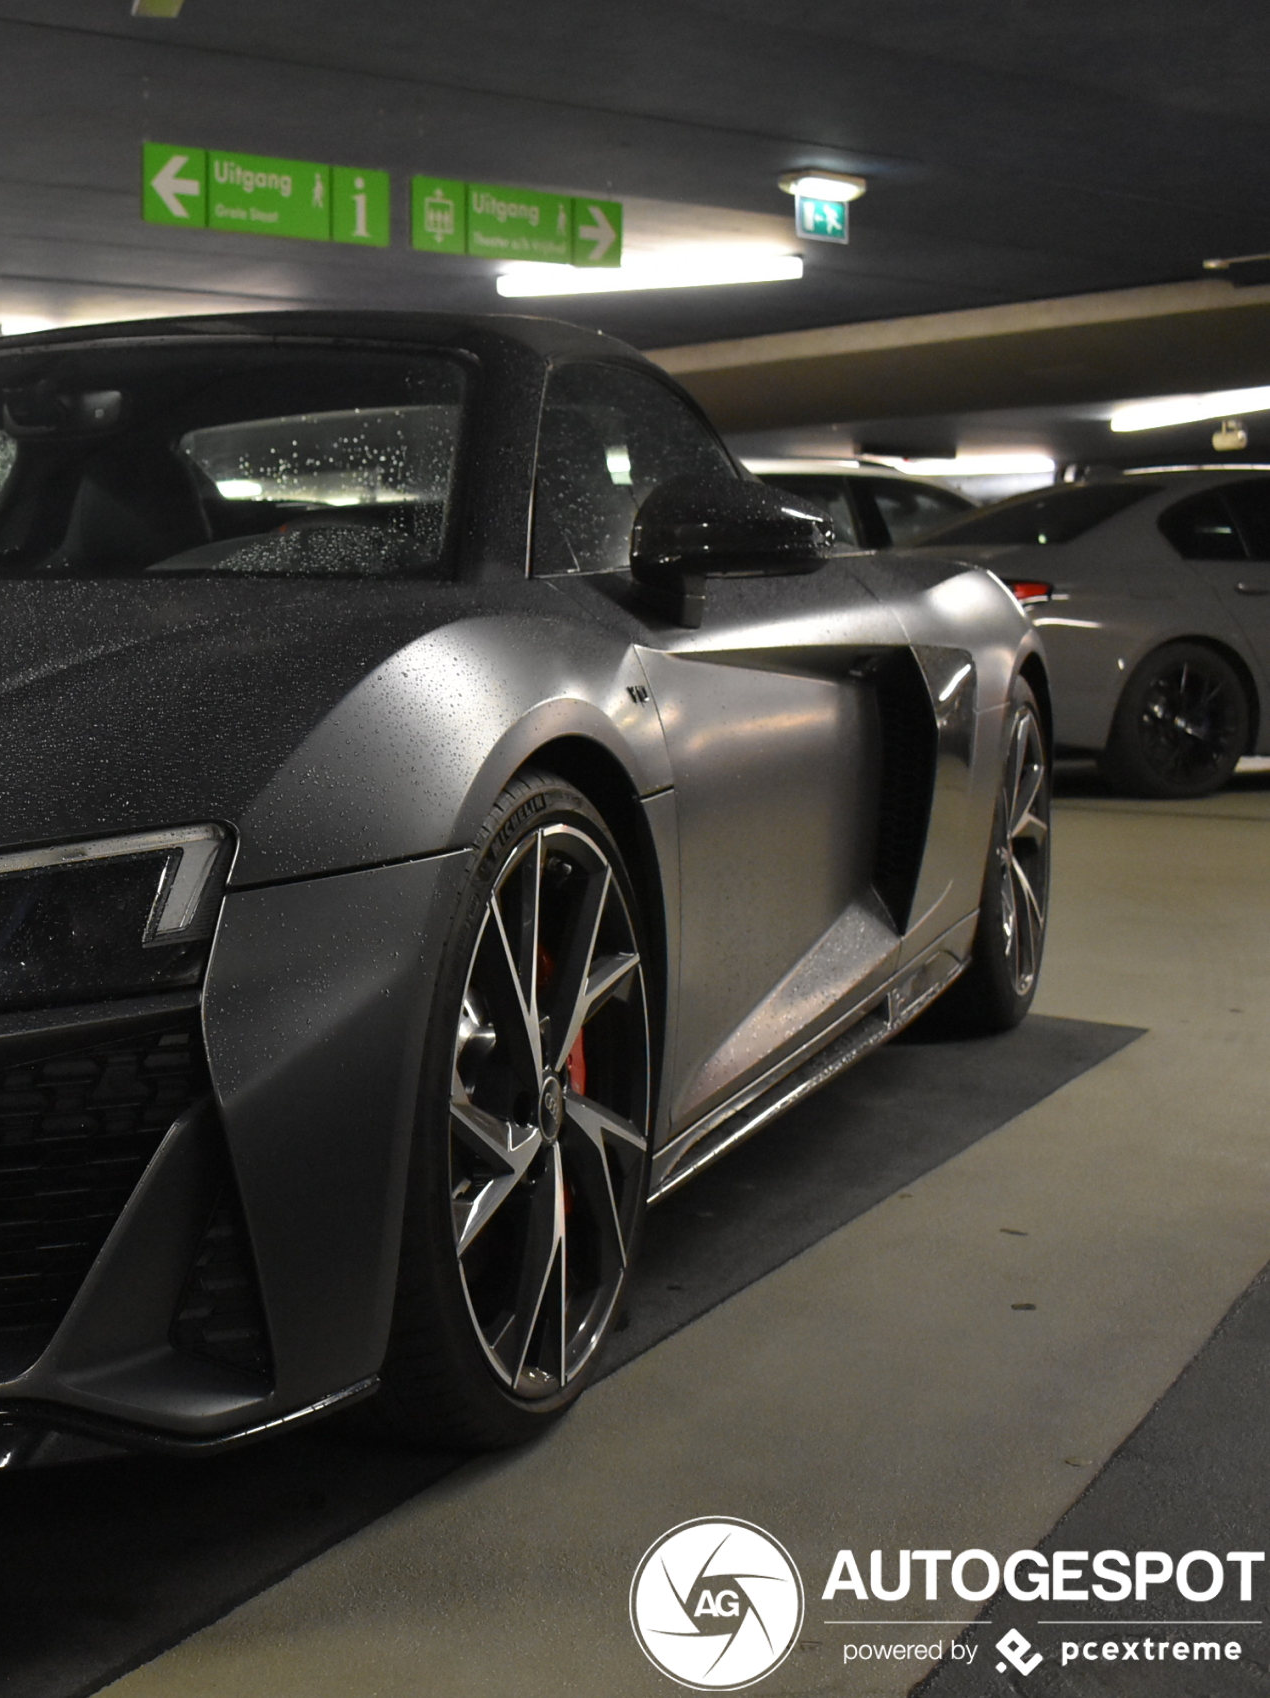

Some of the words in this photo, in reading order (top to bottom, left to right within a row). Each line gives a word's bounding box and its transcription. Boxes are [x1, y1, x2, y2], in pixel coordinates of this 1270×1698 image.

[214, 160, 292, 197] Uitgang
[472, 192, 539, 226] Uitgang
[491, 793, 546, 857] MICHELIN
